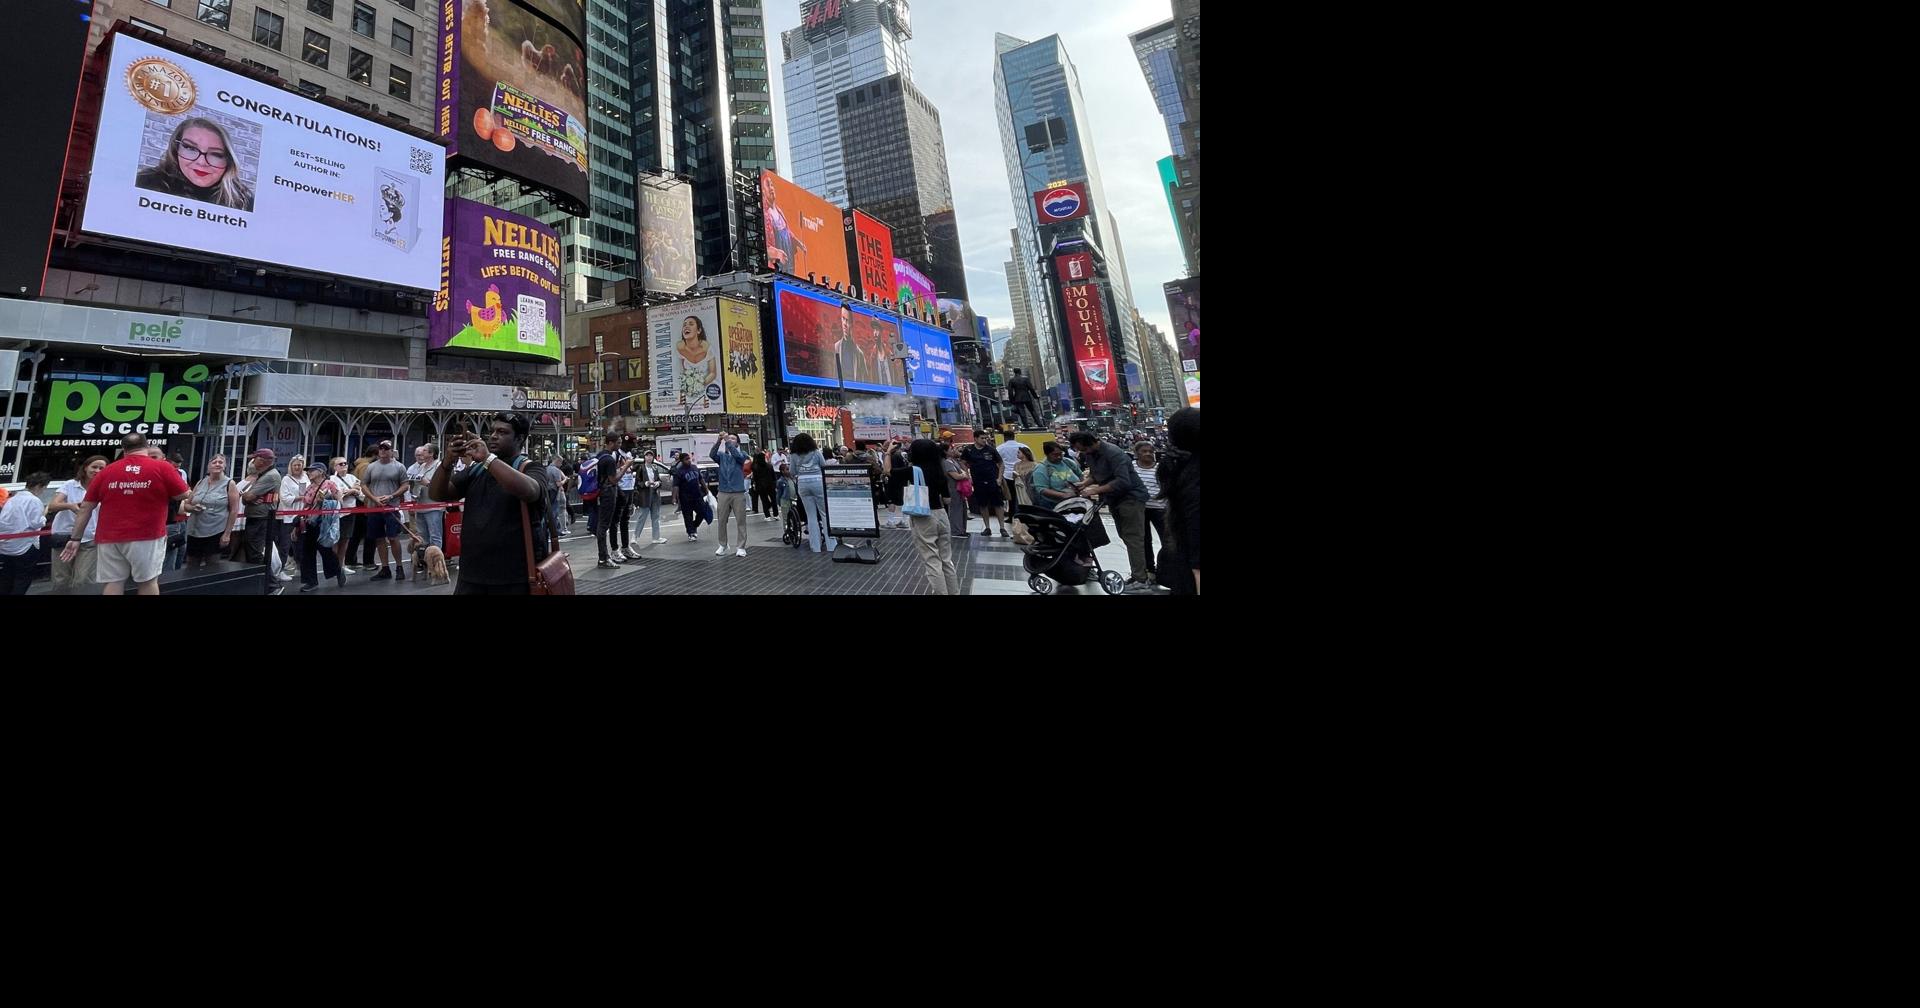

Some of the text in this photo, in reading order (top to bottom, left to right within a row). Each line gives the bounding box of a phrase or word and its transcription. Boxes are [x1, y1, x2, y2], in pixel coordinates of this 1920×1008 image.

[141, 64, 187, 89] AMAZON
[149, 78, 172, 98] #1
[441, 78, 451, 101] OUT
[217, 90, 382, 152] CONGRATULATIONS!
[441, 105, 451, 137] HERE
[502, 91, 560, 128] NELLIE'S
[531, 130, 552, 144] FREE
[553, 139, 577, 157] RANGE
[290, 148, 346, 170] BEST-SELLING
[294, 160, 342, 179] AUTHOR IN:
[274, 175, 355, 204] EmpowerHER
[1047, 180, 1068, 189] 2025
[138, 196, 248, 228] Darcie Burtch
[483, 215, 560, 269] NELLIE'S
[857, 230, 884, 260] THE
[493, 248, 516, 259] FREE
[518, 251, 544, 266] RANGE
[481, 264, 507, 278] LIFE'S
[509, 265, 539, 284] BETTER
[540, 277, 551, 291] OUT
[865, 265, 888, 292] HAS
[129, 318, 184, 340] pelé
[1071, 285, 1097, 358] MOUTAI
[43, 364, 209, 435] pelé
[527, 390, 547, 400] GRAND
[82, 422, 180, 435] SOCCER
[266, 426, 292, 441] 160
[62, 439, 108, 447] GREATEST
